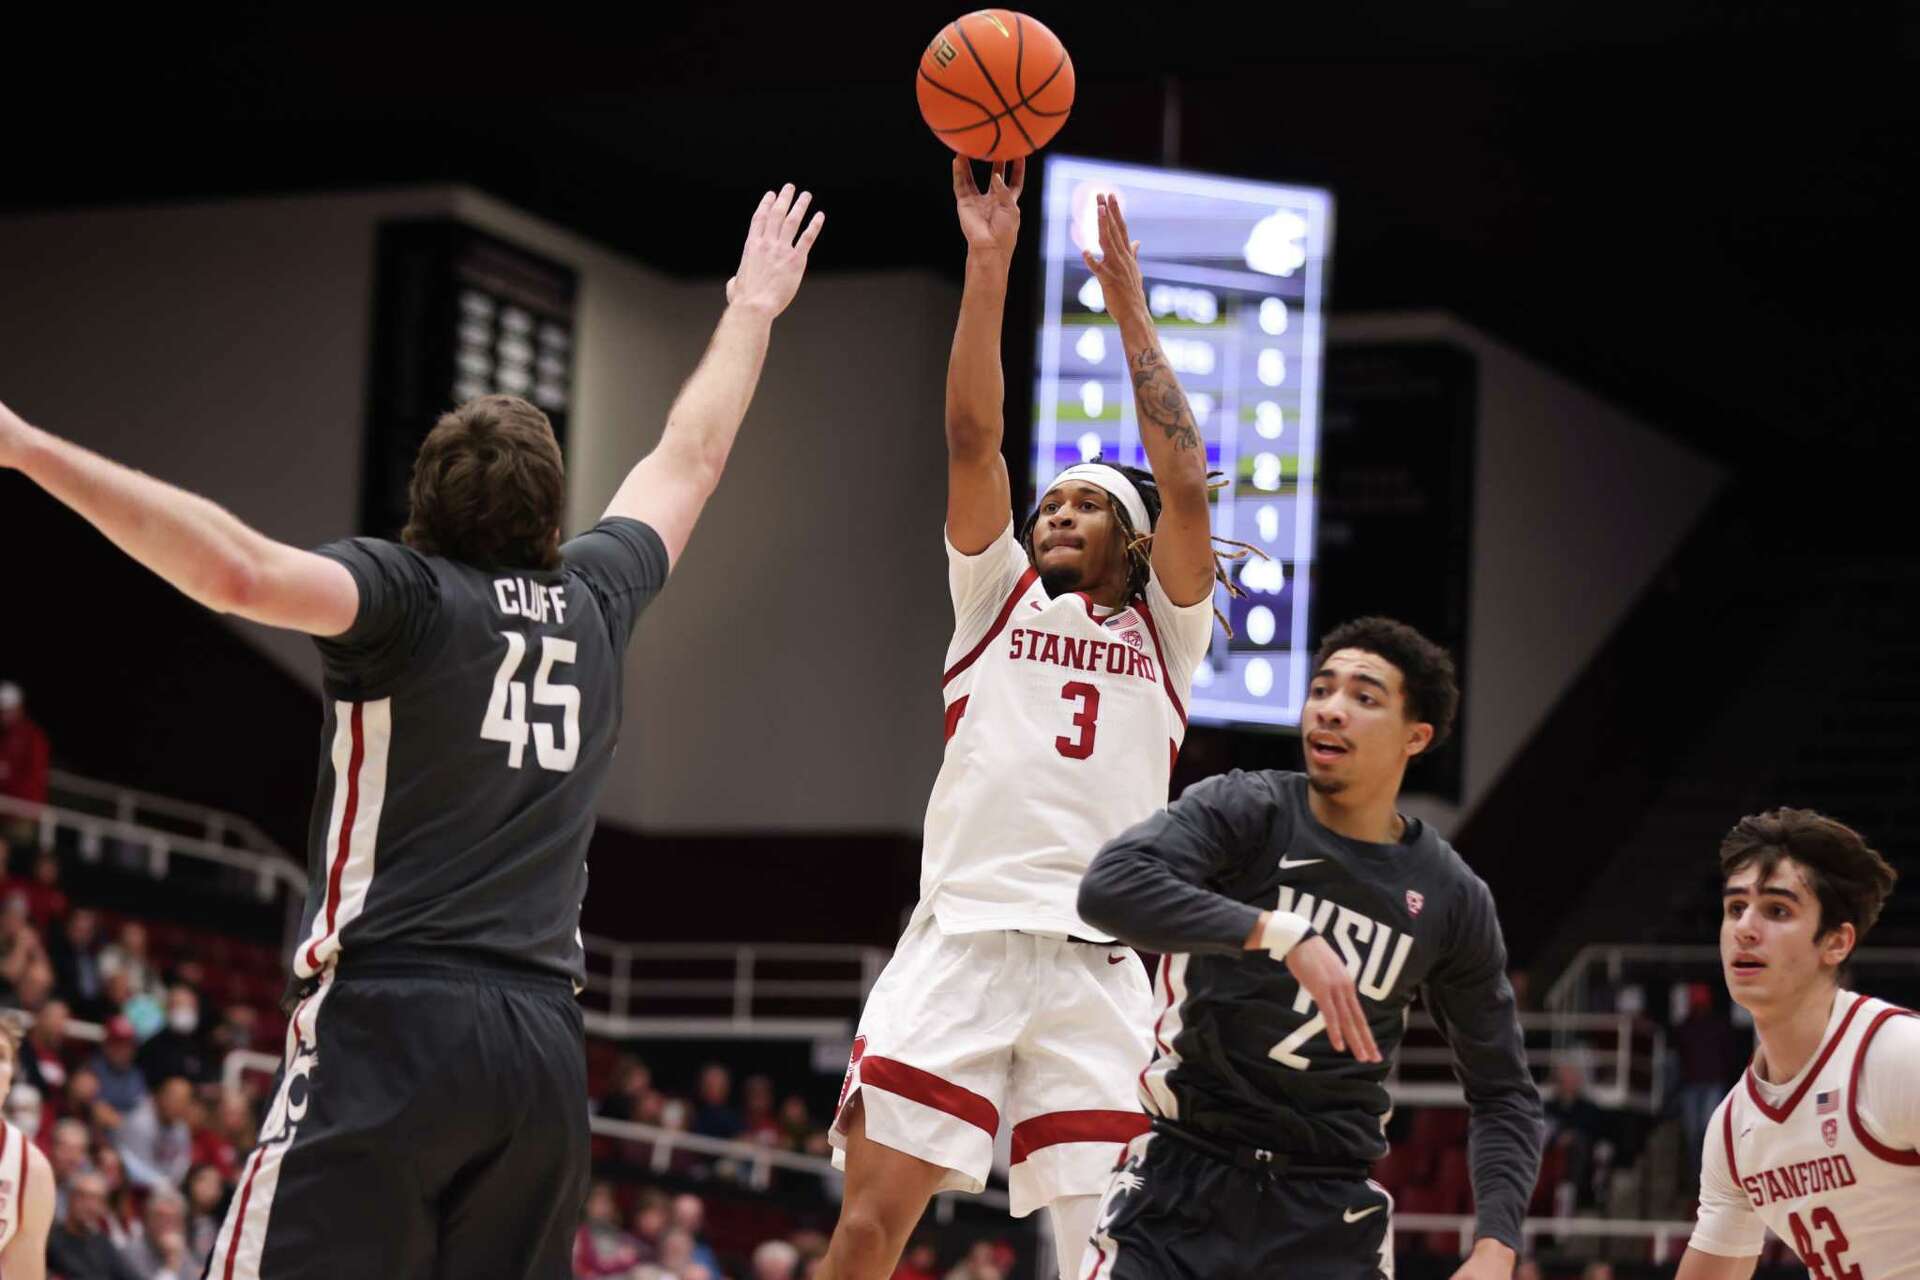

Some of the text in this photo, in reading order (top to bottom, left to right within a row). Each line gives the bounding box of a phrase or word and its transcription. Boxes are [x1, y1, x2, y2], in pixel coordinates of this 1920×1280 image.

[494, 577, 567, 624] CLUFF
[1009, 628, 1157, 684] STANFORD
[480, 631, 581, 773] 45
[1055, 681, 1100, 760] 3
[1742, 1153, 1857, 1208] STANFORD
[1788, 1206, 1863, 1280] 42
